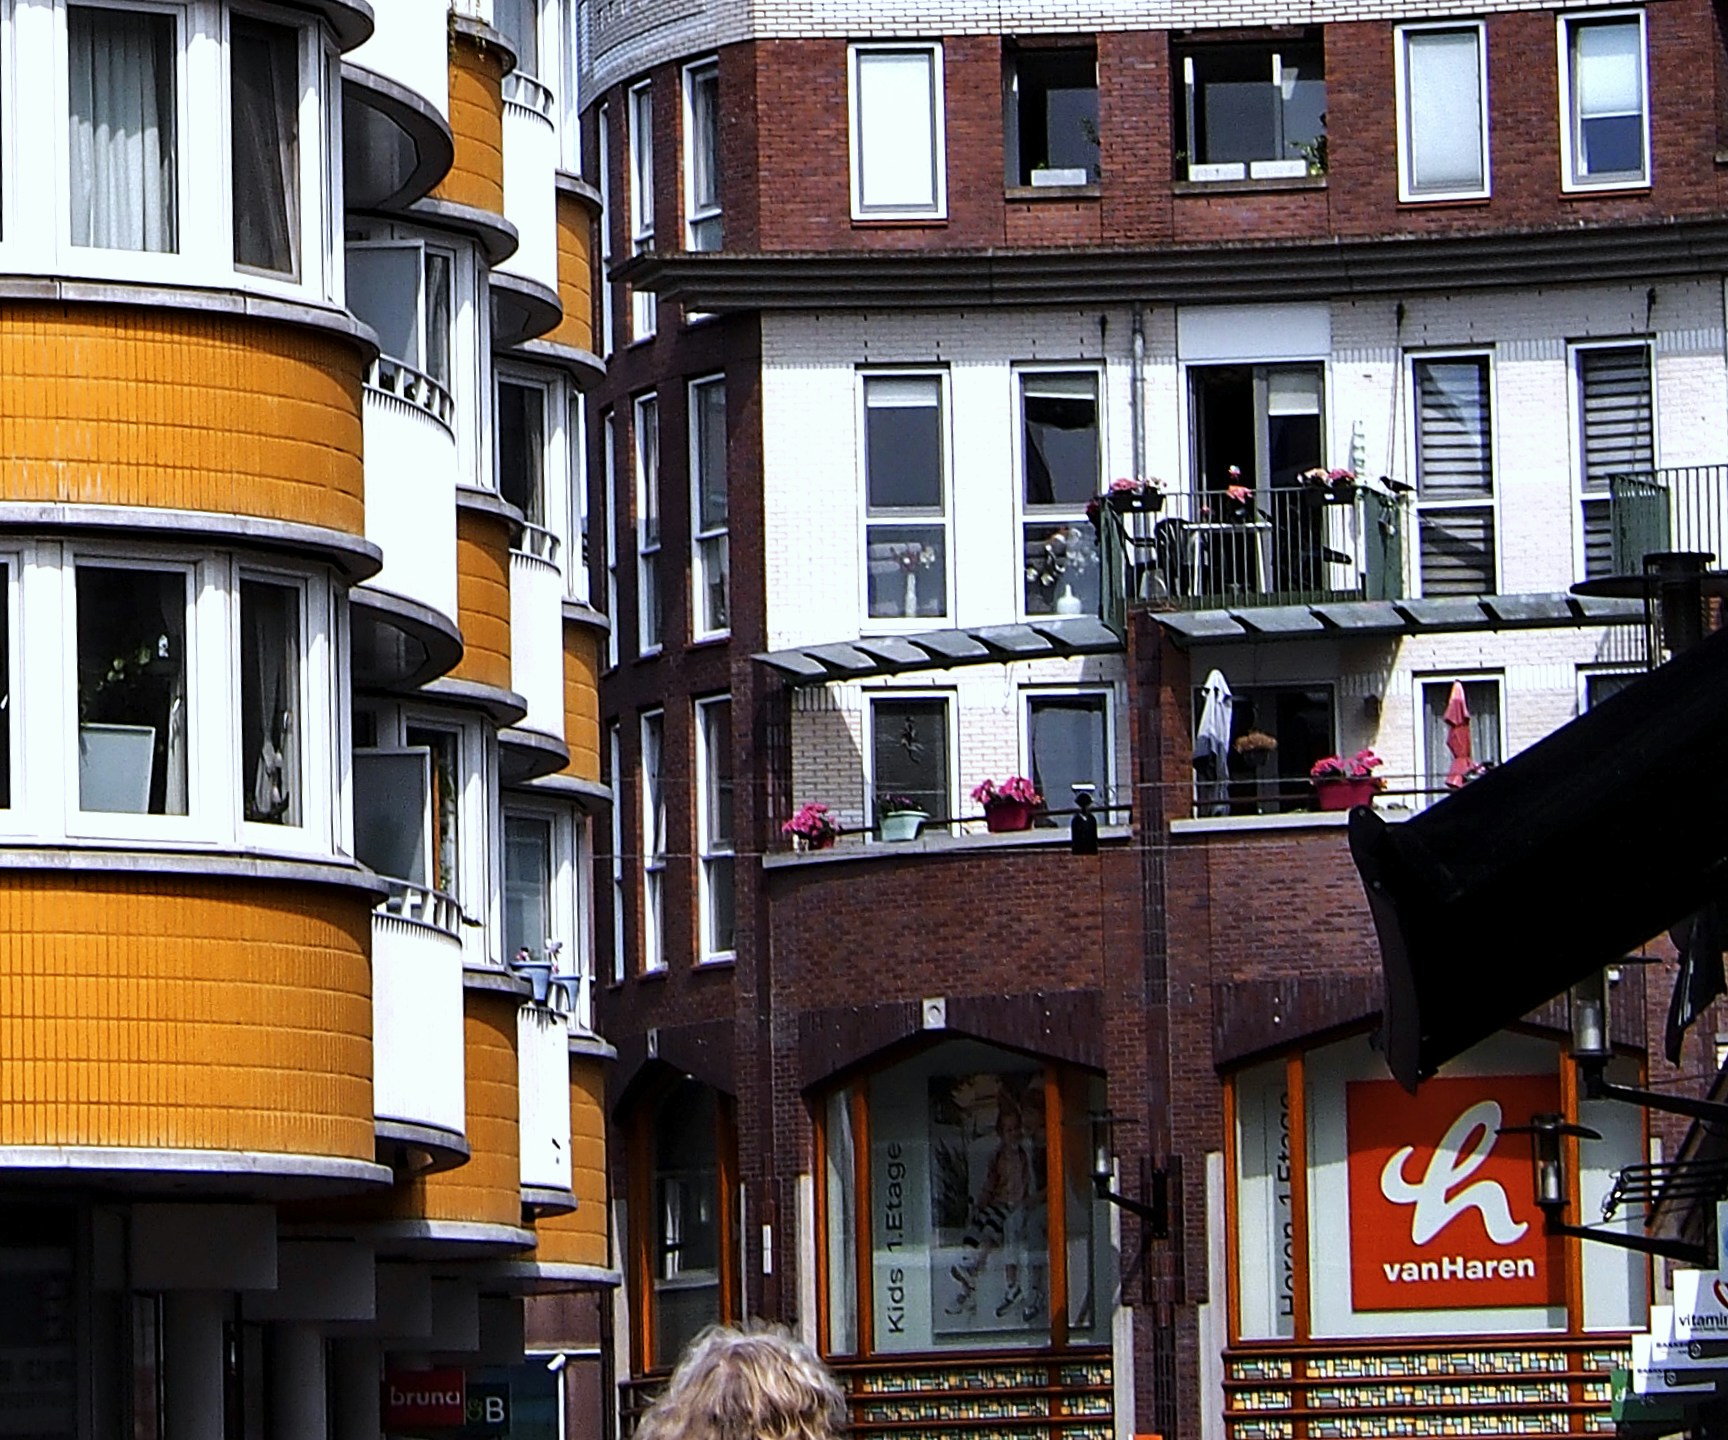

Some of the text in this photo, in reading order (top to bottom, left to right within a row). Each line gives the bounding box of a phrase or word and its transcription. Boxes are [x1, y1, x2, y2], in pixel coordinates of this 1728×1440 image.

[885, 1141, 906, 1334] Kids 1.Etage
[1383, 1256, 1535, 1282] vanHaren
[390, 1385, 460, 1406] bruna
